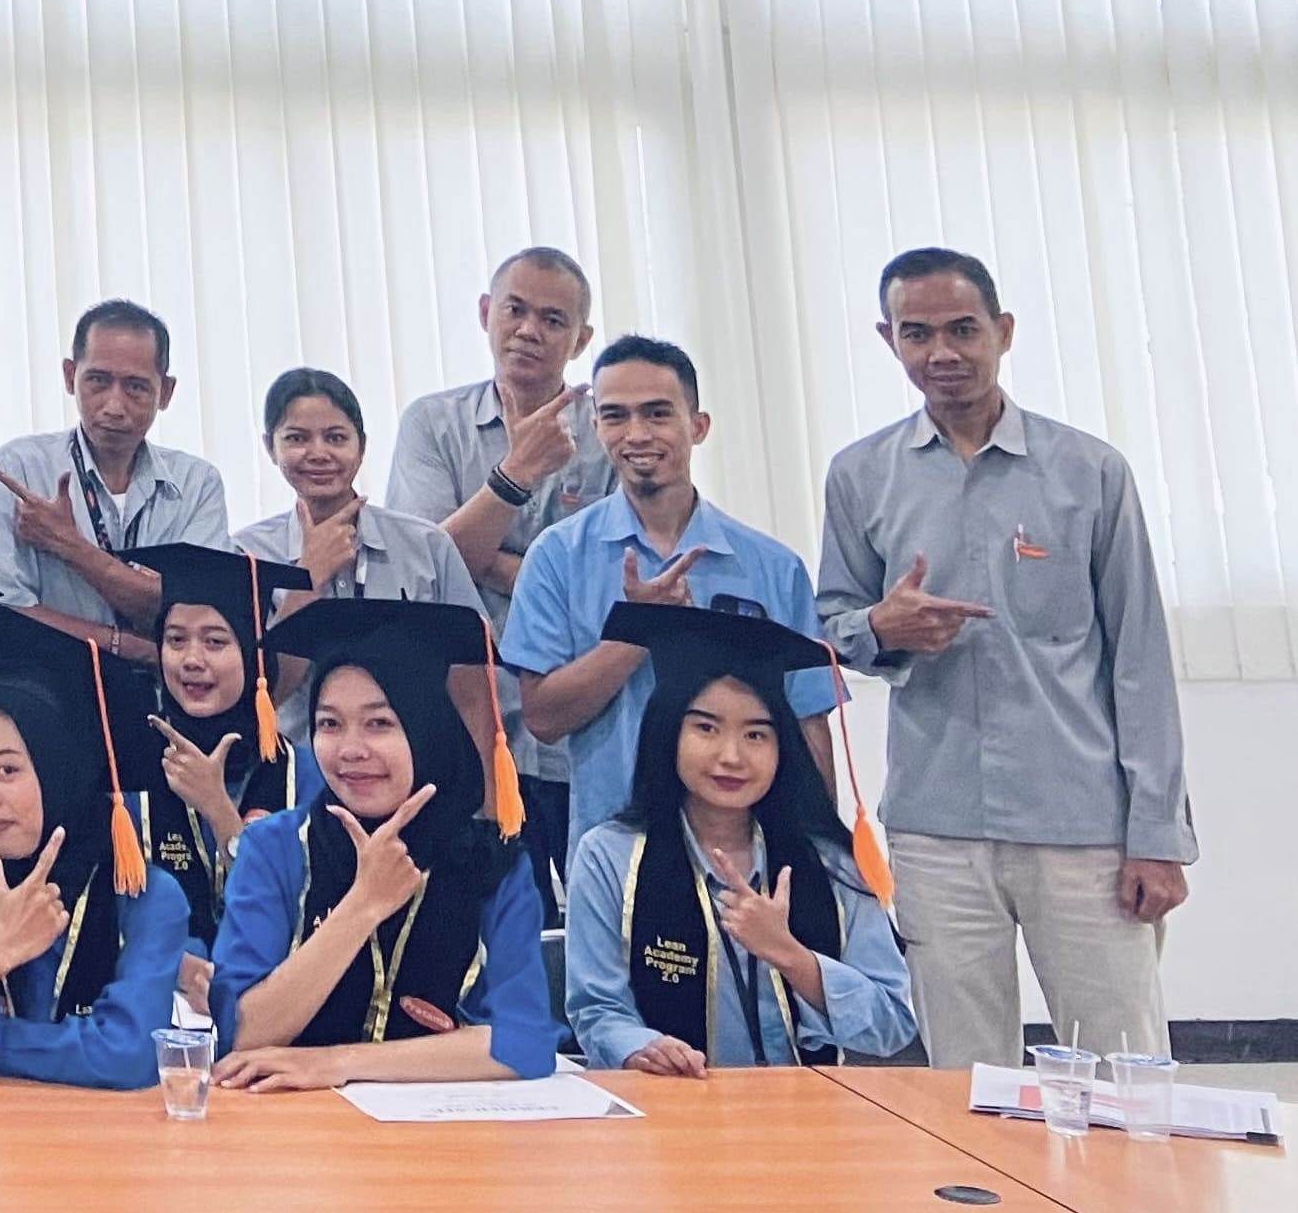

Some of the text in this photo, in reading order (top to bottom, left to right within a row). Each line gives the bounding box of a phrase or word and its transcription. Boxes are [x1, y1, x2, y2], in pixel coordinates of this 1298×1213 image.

[656, 933, 687, 953] Lean
[644, 944, 699, 968] Academy
[645, 956, 697, 976] Program
[661, 970, 680, 984] 2.0
